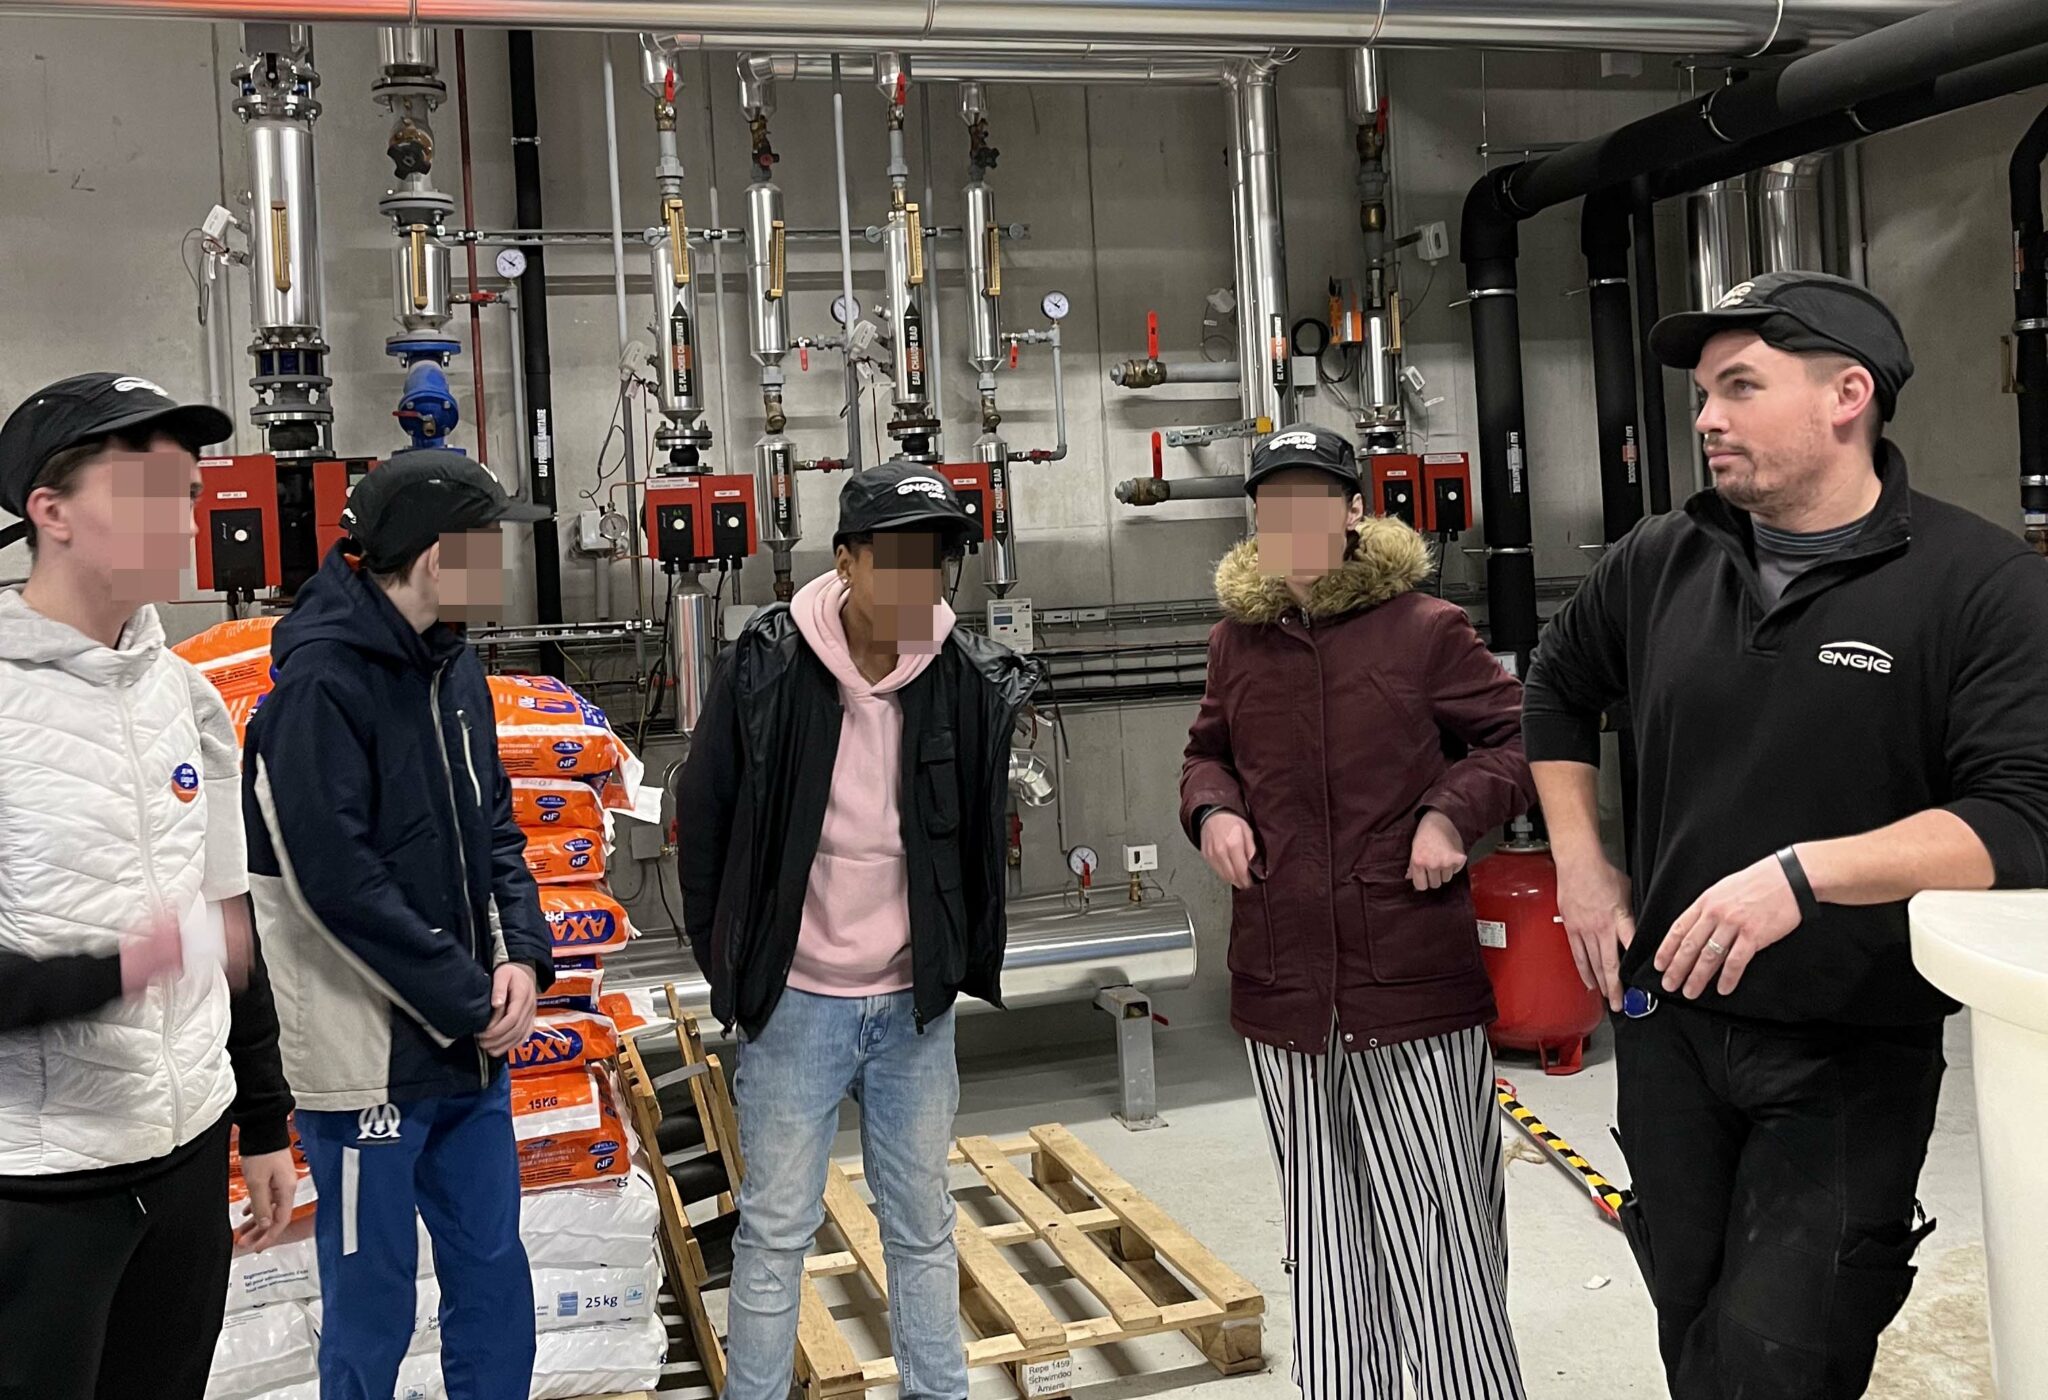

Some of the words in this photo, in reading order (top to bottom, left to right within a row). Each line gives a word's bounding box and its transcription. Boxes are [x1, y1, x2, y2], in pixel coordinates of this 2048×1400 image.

[675, 321, 685, 354] CHAUFFANT
[908, 326, 918, 340] RAD
[910, 342, 920, 370] CHAUDE
[677, 355, 687, 384] PLANCHER
[912, 371, 921, 385] EAU
[536, 408, 547, 440] SANITAIRE
[1510, 432, 1519, 443] EAU
[537, 441, 548, 464] FROIDE
[538, 464, 548, 477] EAU
[993, 468, 1002, 482] RAD
[994, 483, 1003, 509] CHAUDE
[996, 510, 1005, 523] EAU
[1818, 649, 1892, 674] ENGIE
[559, 758, 577, 767] NF
[542, 812, 559, 821] NF
[571, 855, 589, 866] NF
[544, 910, 565, 923] PR
[549, 917, 607, 941] AXA
[596, 1157, 614, 1169] NF
[585, 1296, 601, 1309] 25
[603, 1294, 619, 1307] kg
[1052, 1359, 1071, 1369] 1459
[1037, 1382, 1066, 1393] Amiens
